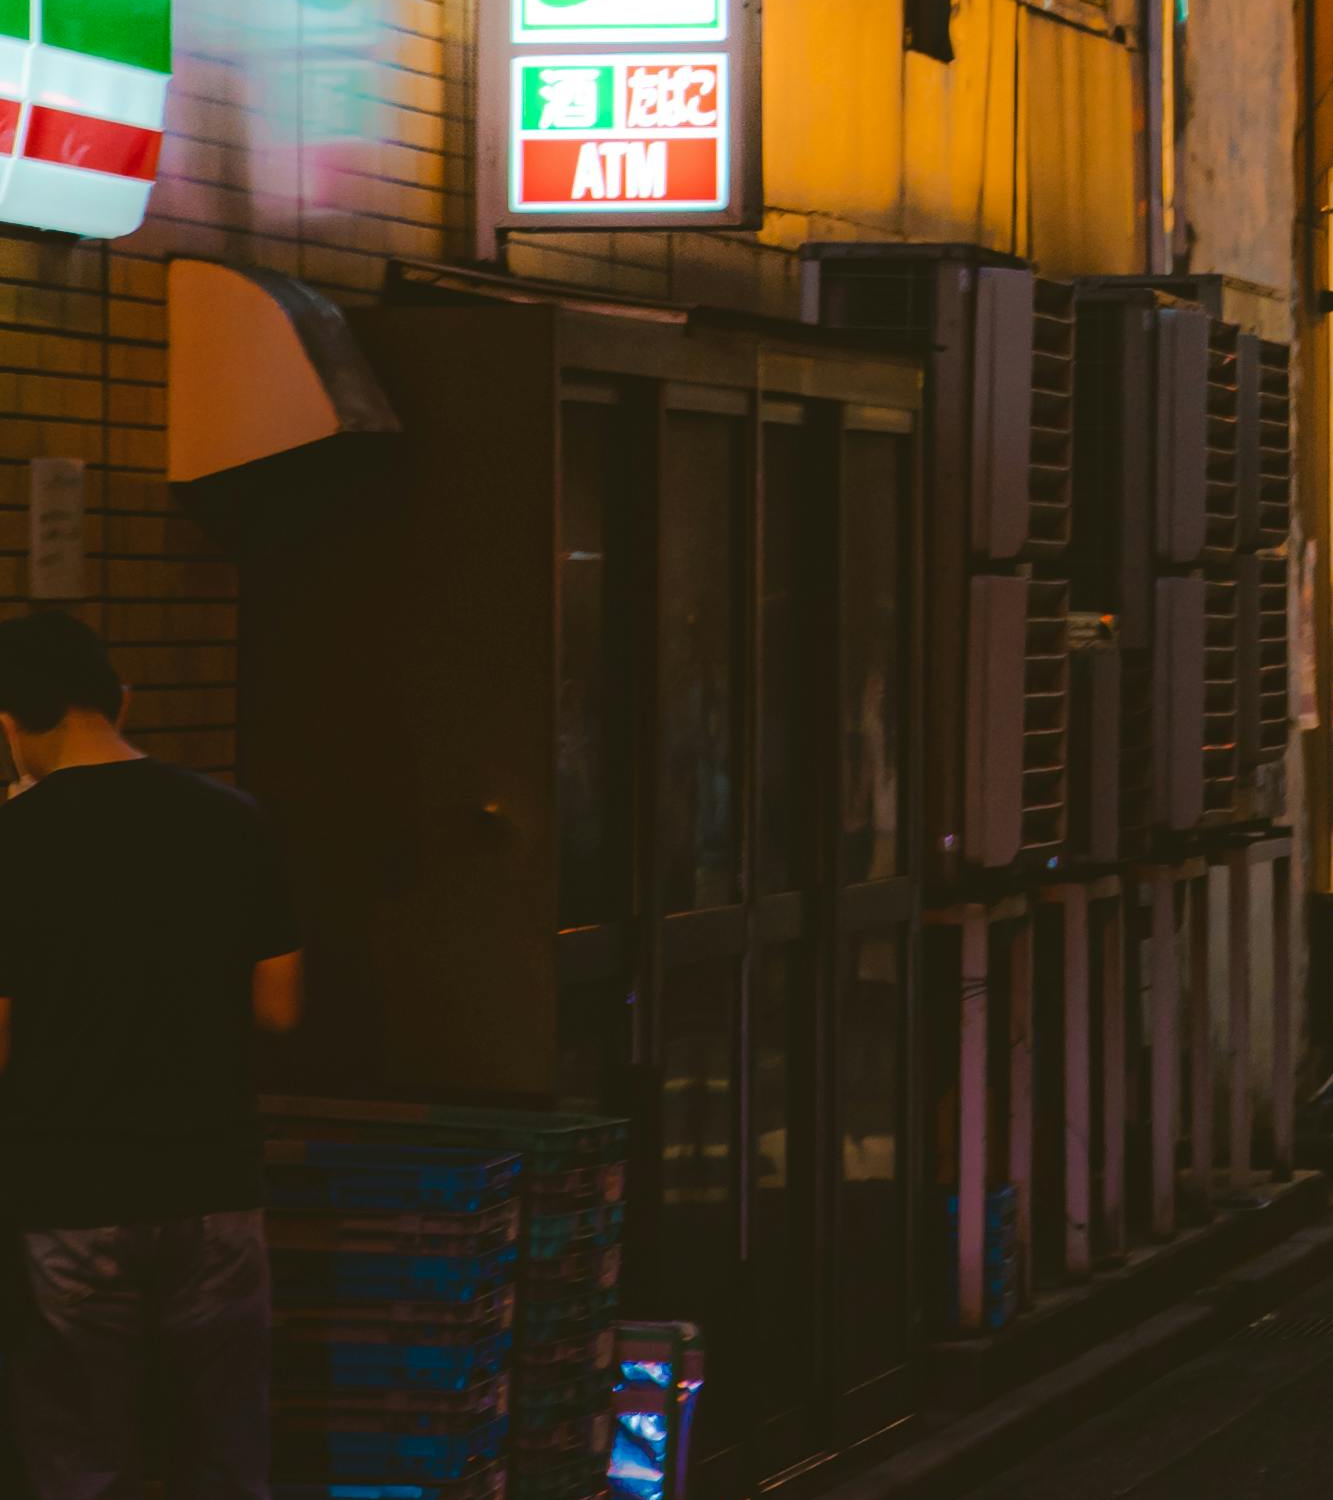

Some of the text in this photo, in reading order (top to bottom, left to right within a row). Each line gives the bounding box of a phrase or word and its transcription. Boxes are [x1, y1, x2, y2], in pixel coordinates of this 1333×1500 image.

[541, 69, 599, 128] 酒
[627, 66, 718, 127] たばこ
[572, 142, 667, 199] ATM
